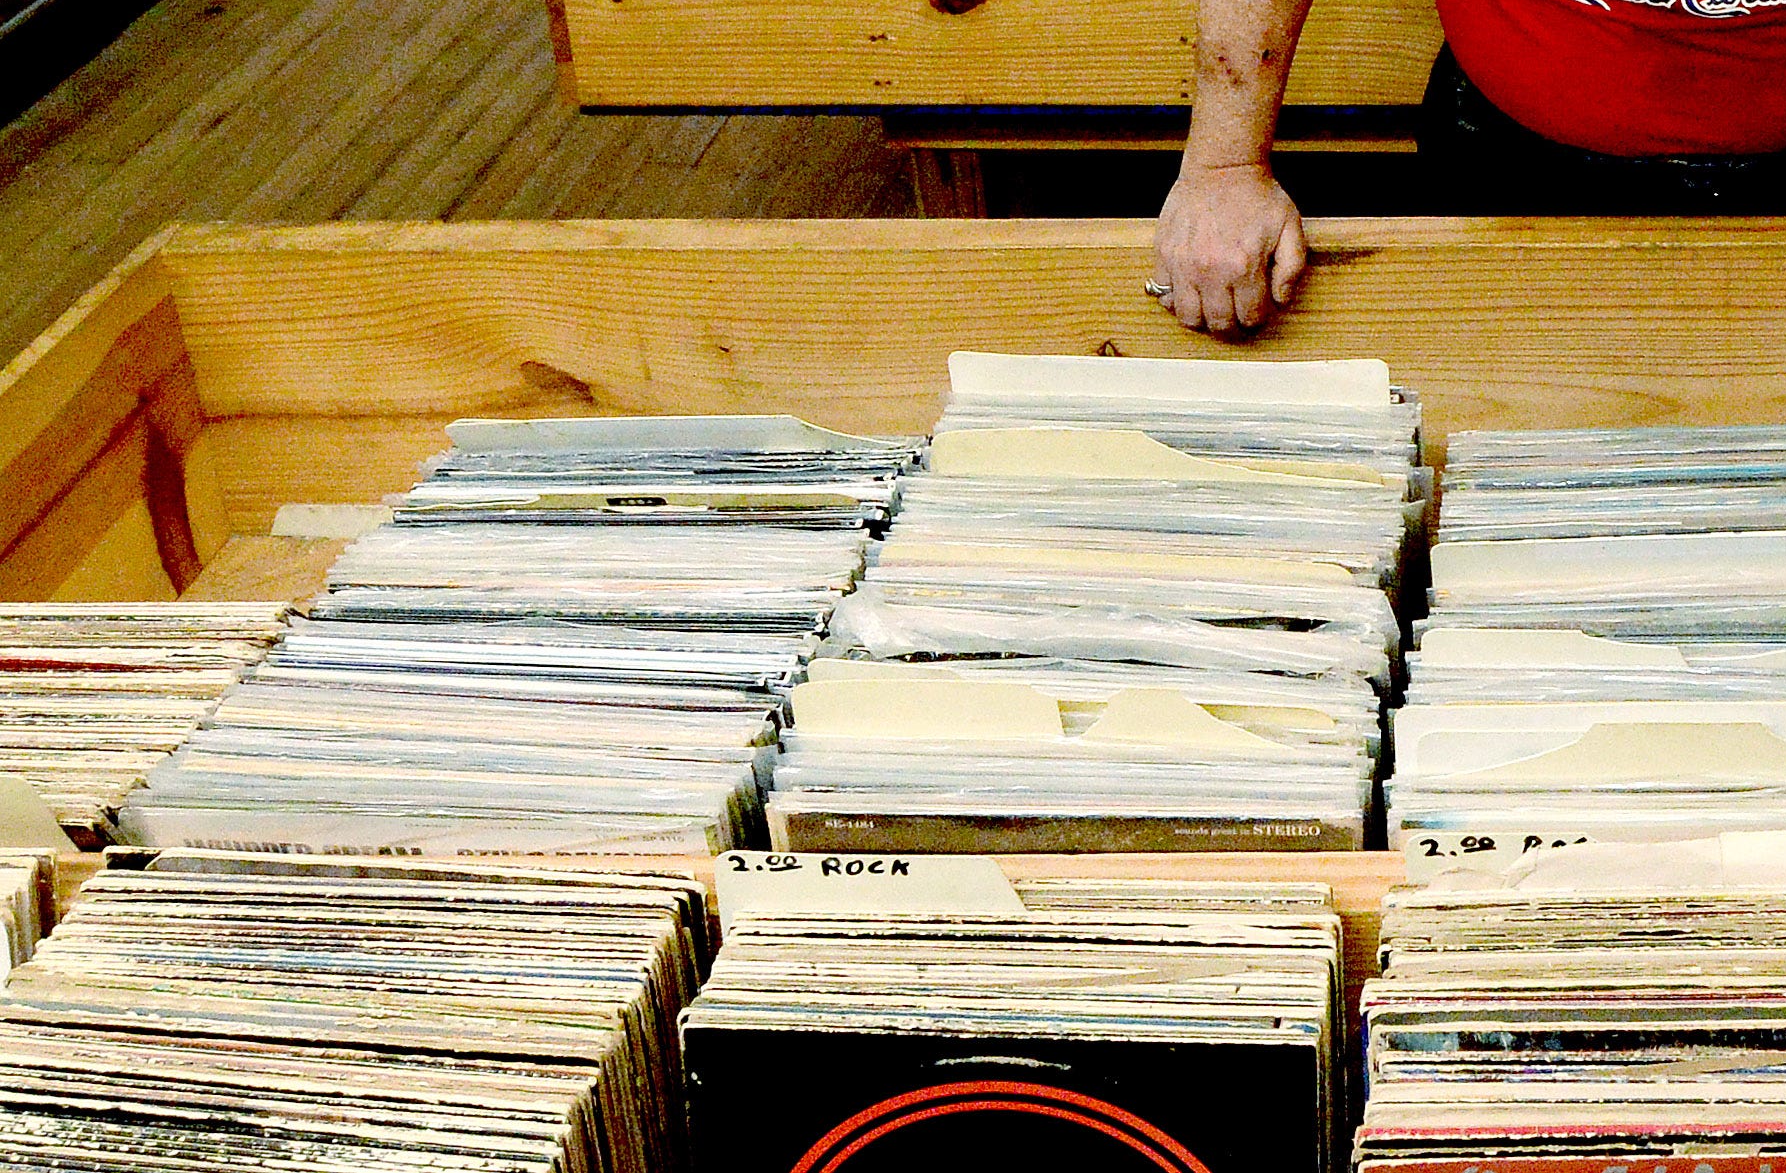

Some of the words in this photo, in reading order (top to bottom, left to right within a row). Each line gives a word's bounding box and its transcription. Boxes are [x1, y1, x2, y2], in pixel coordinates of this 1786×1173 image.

[1252, 824, 1321, 837] STEREO
[1420, 835, 1496, 858] 2.00
[728, 854, 803, 873] 2.00
[821, 856, 911, 877] ROCK
